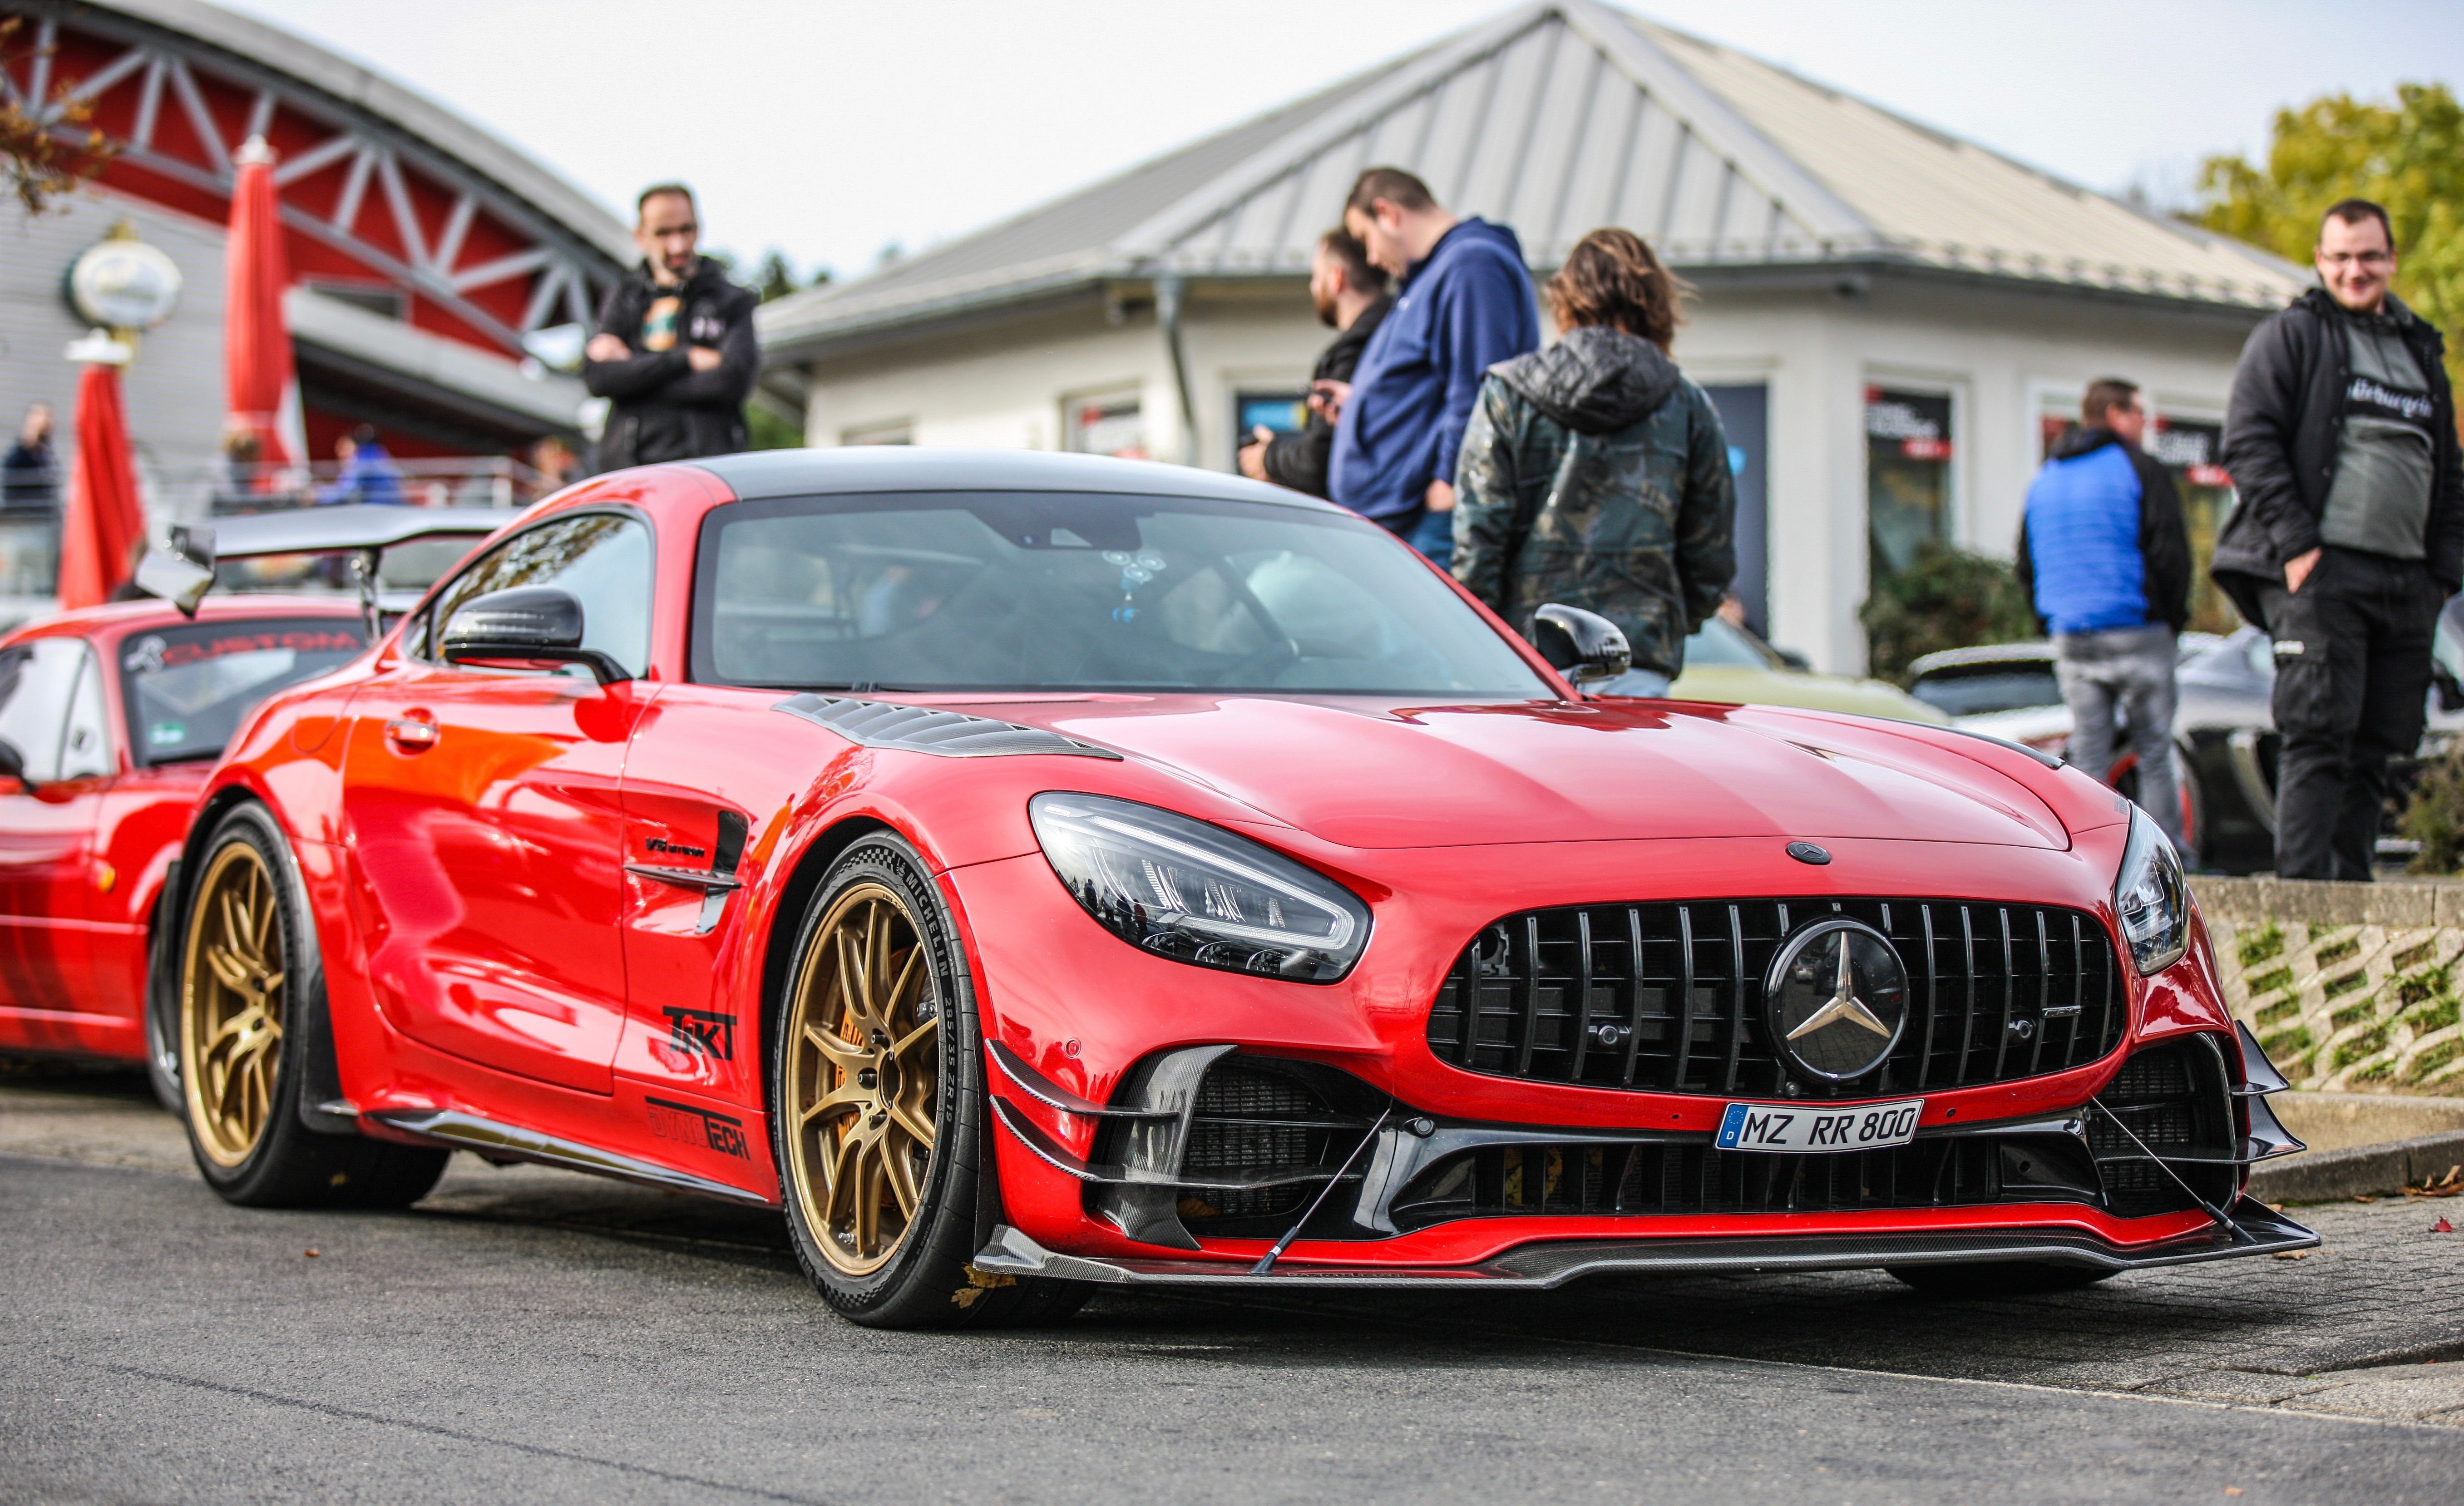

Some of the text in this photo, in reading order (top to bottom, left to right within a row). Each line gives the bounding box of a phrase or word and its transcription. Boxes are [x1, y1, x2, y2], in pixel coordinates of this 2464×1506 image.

[906, 872, 948, 976] MICHELIN
[944, 997, 955, 1122] 285/35 ZR 19
[1726, 1131, 1734, 1140] D
[1742, 1107, 1916, 1145] MZ RR 800
